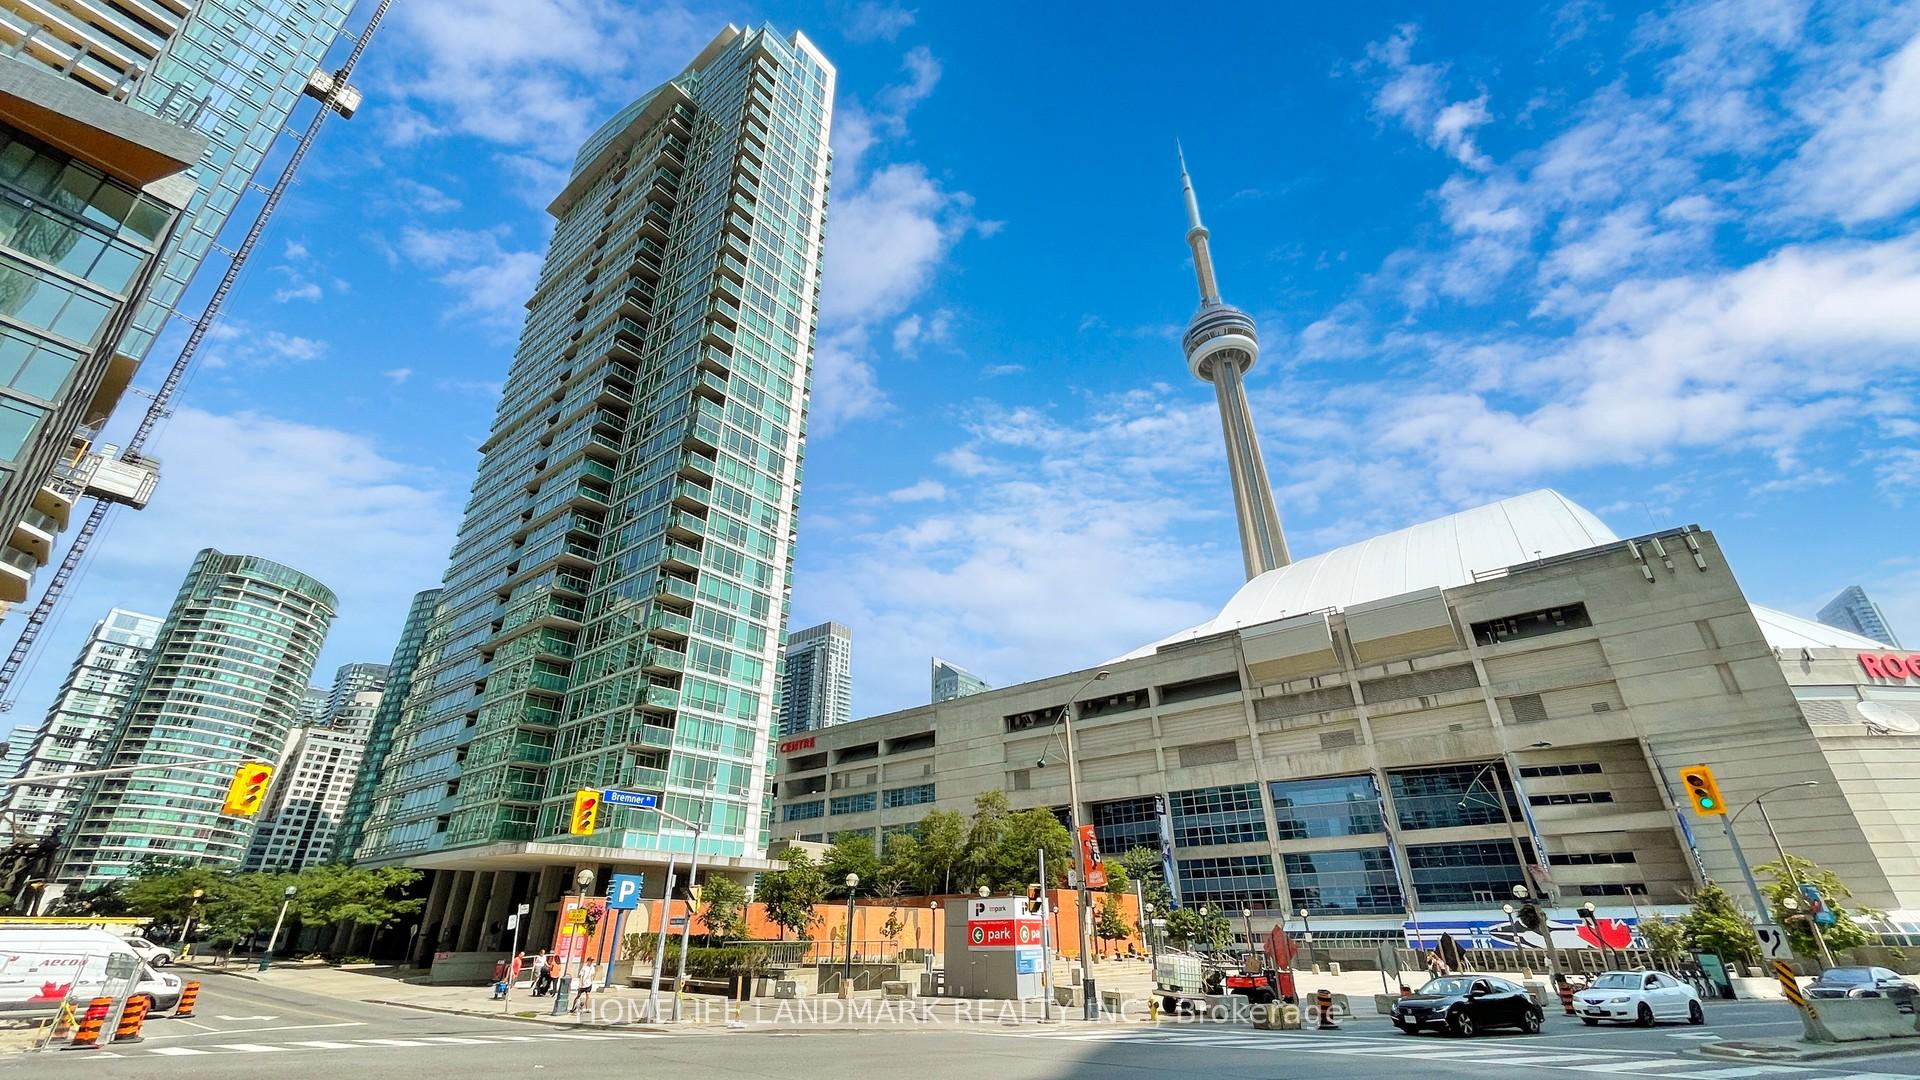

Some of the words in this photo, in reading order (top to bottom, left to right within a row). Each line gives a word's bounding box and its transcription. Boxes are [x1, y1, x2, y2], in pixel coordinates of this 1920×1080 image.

[780, 736, 815, 752] CENTRE
[611, 792, 644, 804] Bremner
[618, 880, 635, 902] P
[988, 927, 1010, 942] park
